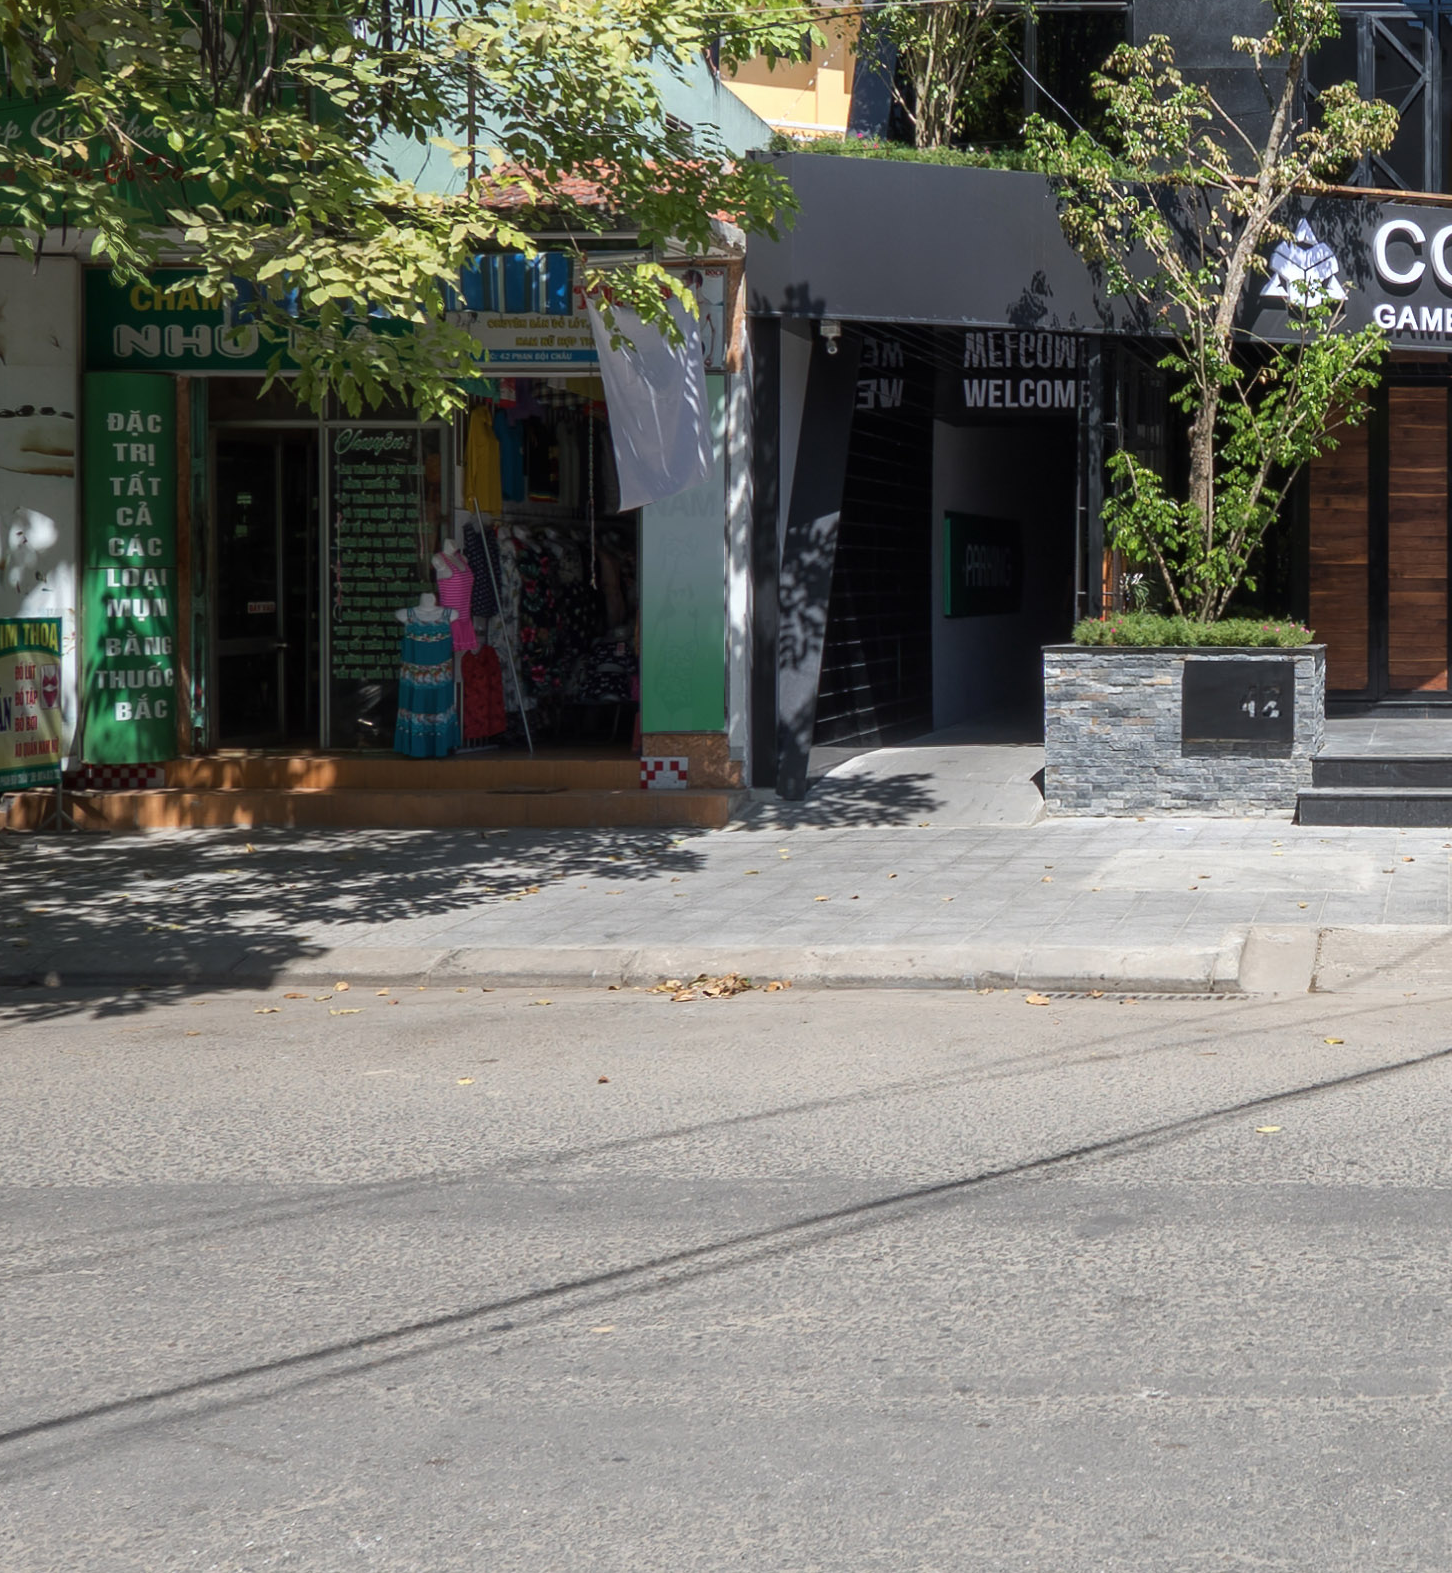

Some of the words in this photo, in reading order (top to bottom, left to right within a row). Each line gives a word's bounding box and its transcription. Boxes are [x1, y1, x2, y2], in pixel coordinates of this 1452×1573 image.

[530, 316, 549, 328] BÁN
[500, 352, 510, 360] 42
[512, 352, 533, 360] PHAN
[550, 350, 573, 360] CHÂU
[963, 379, 1091, 408] WELCOME
[106, 410, 162, 436] ĐẶC
[113, 443, 155, 467] TRỊ
[109, 470, 161, 496] TẤT
[116, 501, 153, 526] CẢ
[108, 533, 162, 557] CÁC
[106, 568, 167, 591] LOẠI
[107, 598, 168, 622] MỤN
[23, 622, 59, 652] THOA
[105, 630, 172, 656] BẰNG
[95, 661, 174, 689] THUỐC
[115, 693, 168, 721] BẮC
